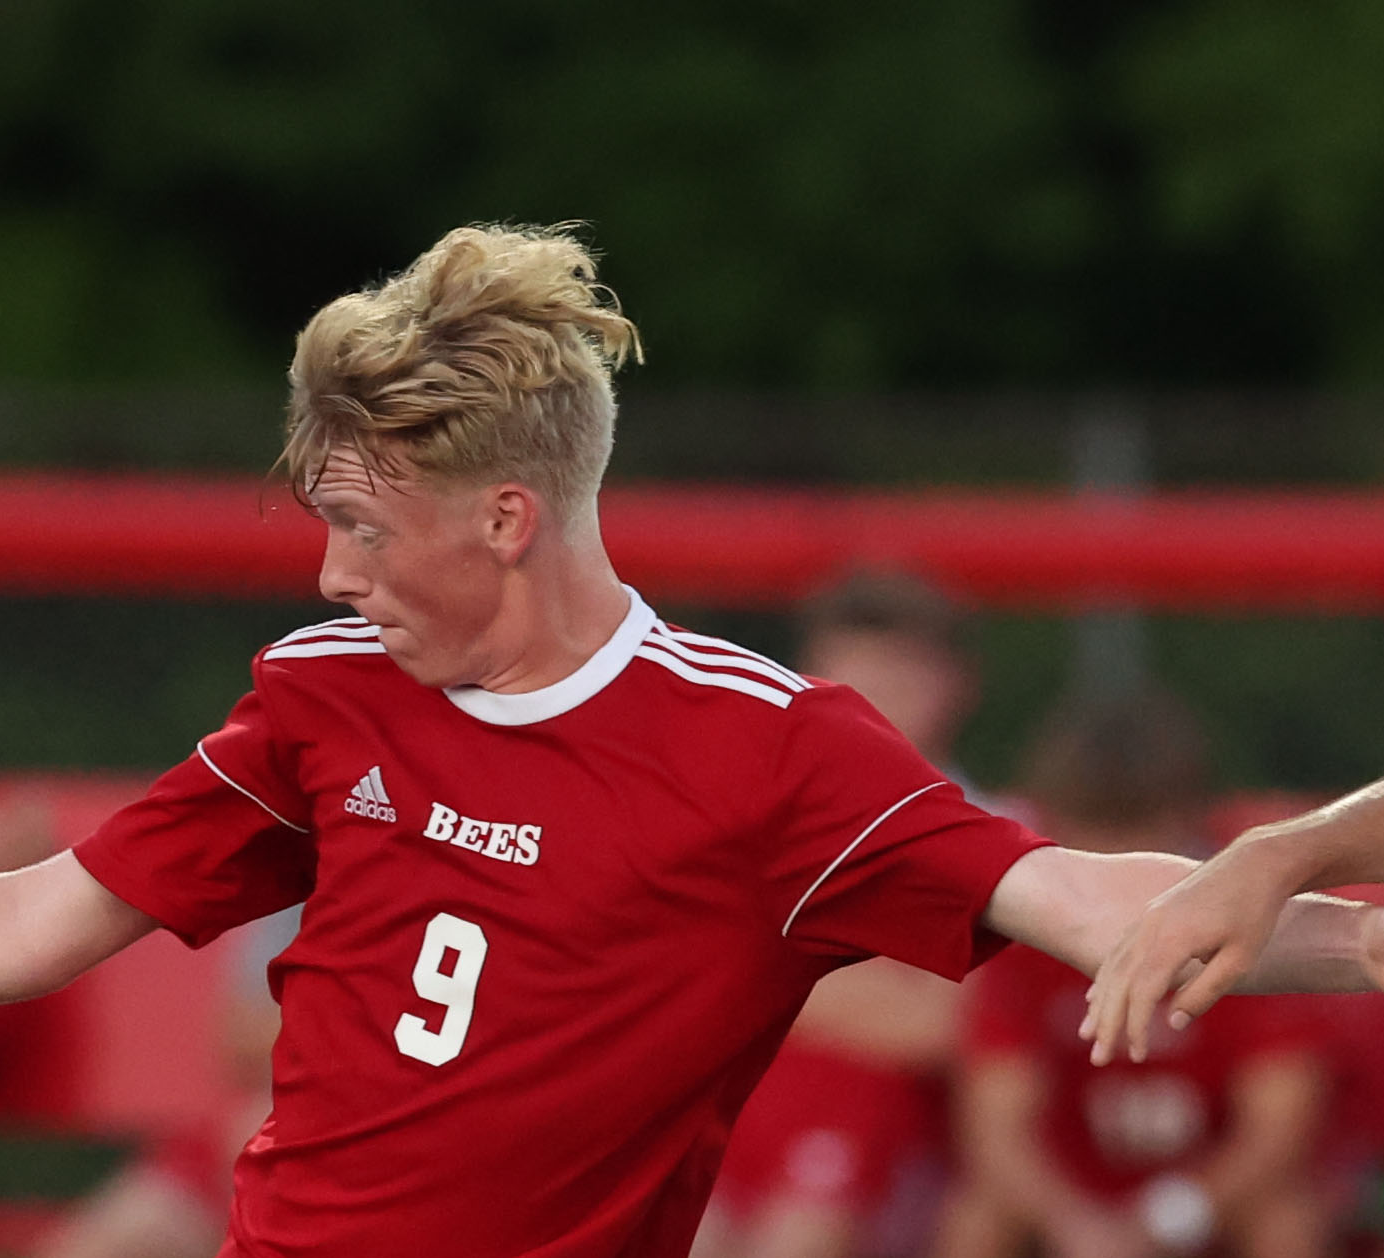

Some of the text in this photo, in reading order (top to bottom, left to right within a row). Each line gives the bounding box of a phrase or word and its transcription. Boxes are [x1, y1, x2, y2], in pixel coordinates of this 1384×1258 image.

[344, 797, 397, 823] adidas
[422, 801, 543, 867] BEES
[393, 911, 489, 1068] 9
